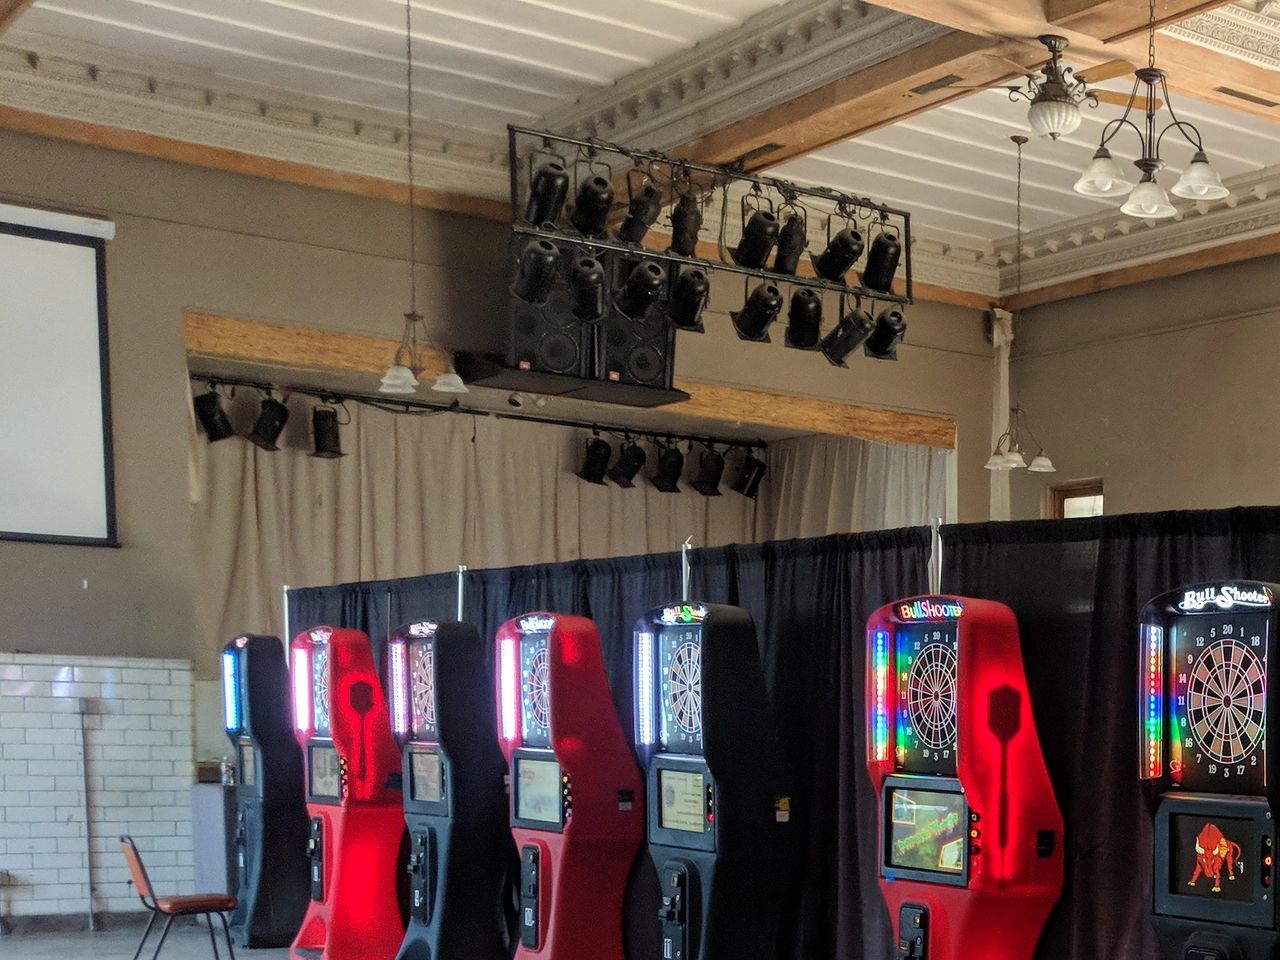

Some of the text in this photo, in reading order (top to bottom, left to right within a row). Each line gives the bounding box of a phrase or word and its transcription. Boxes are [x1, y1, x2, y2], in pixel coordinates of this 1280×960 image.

[1179, 587, 1215, 609] Bull
[1210, 628, 1215, 637] 5
[1223, 625, 1233, 634] 20
[1240, 628, 1244, 636] 1
[1196, 637, 1204, 646] 12
[1251, 636, 1260, 645] 18
[1188, 655, 1193, 664] 9
[1179, 674, 1186, 683] 14
[1178, 696, 1184, 705] 11
[1181, 718, 1186, 727] 8
[1185, 739, 1193, 748] 16
[1196, 754, 1201, 763] 7
[1251, 756, 1257, 765] 2
[1209, 765, 1216, 774] 19
[1224, 768, 1229, 777] 3
[1237, 766, 1245, 775] 17
